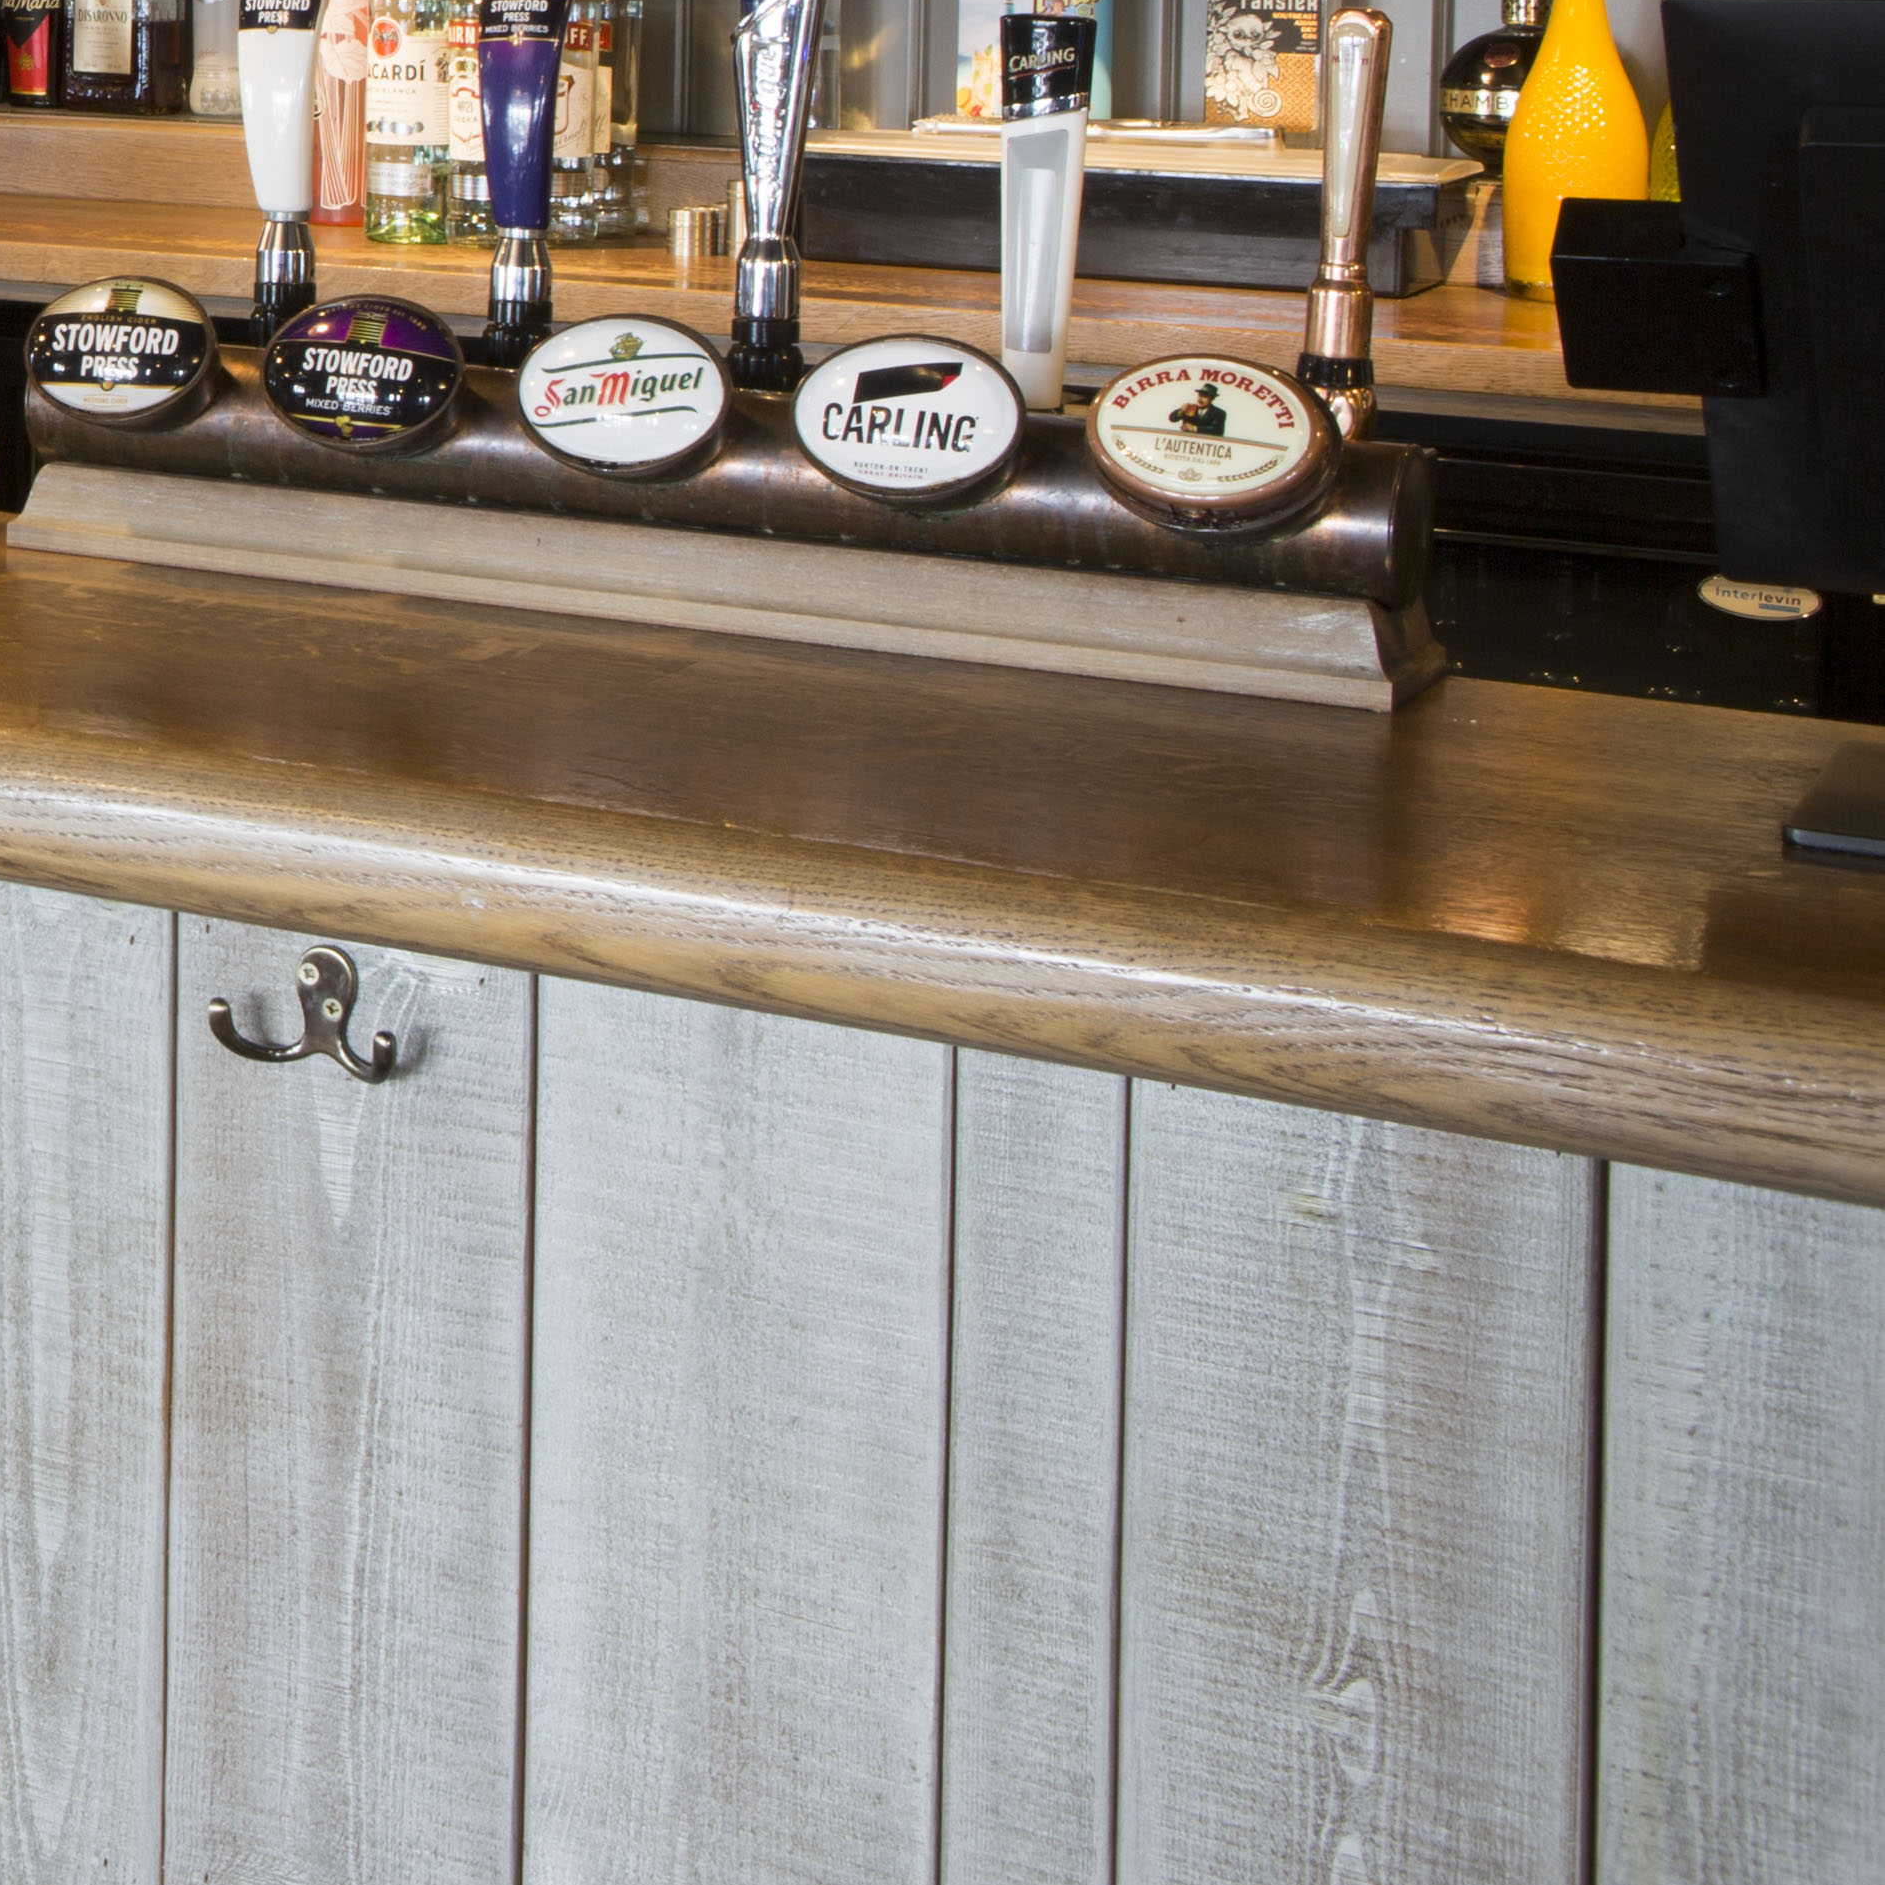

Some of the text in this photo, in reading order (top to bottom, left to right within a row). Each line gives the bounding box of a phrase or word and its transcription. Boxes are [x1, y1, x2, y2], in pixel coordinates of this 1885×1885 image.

[78, 7, 128, 25] DISARONNO
[257, 10, 289, 25] PRESS
[502, 11, 530, 23] PRESS
[1272, 12, 1319, 20] SOUTHEAST
[484, 23, 550, 34] MIXED BERRIES
[1008, 47, 1076, 74] CARLING
[80, 315, 157, 325] ENGLISH CIDER
[52, 323, 179, 355] STOWFORD
[79, 356, 139, 379] PRESS
[302, 348, 413, 382] STOWFORD
[325, 375, 378, 402] PRESS
[534, 367, 704, 418] San Miguel
[1112, 368, 1296, 430] BIRRA MORETTI
[304, 397, 393, 416] MIXED BERRIES
[822, 401, 978, 453] CARLING
[1154, 435, 1232, 460] L'AUTENTICA
[857, 469, 924, 480] GREAT BRITAIN
